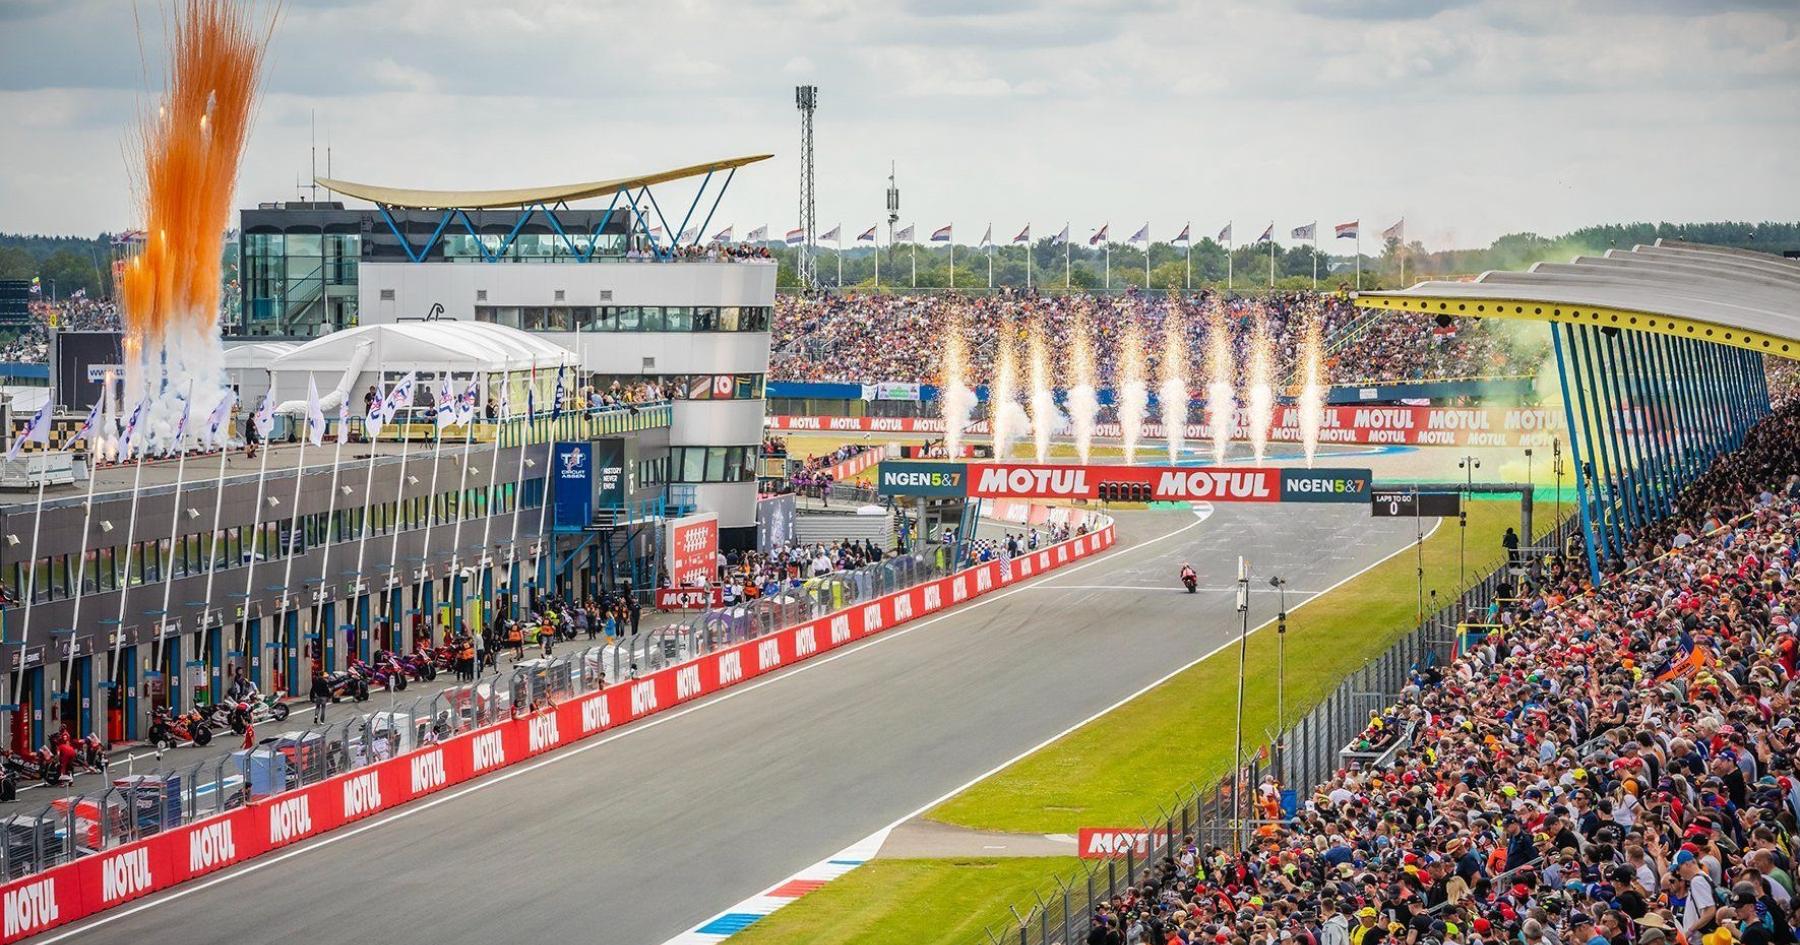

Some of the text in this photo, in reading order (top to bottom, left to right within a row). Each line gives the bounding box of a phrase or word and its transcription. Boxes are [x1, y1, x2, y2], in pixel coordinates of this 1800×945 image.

[789, 417, 820, 429] MOTUL
[830, 417, 861, 429] MOTUL
[870, 418, 903, 430] MOTUL
[1283, 409, 1340, 427] MUL
[1354, 409, 1413, 428] MOTUL
[1429, 410, 1489, 429] MOTUL
[1092, 424, 1121, 436] OTUL
[1272, 428, 1301, 440] MOTU
[1320, 429, 1357, 442] MOTUL
[1368, 430, 1405, 443] MOTUL
[1418, 431, 1455, 444] MOTUL
[1468, 432, 1507, 446] MOTUL
[885, 472, 961, 487] NGEN5&7
[978, 469, 1091, 494] MOTUL
[1156, 471, 1270, 497] MOTUL
[1286, 479, 1365, 493] NGEN5&7
[1390, 501, 1398, 515] 0
[796, 626, 817, 657] MOTUL
[758, 638, 781, 671] MOTUL
[719, 650, 743, 685] MOTUL
[676, 664, 702, 700] MOTUL
[631, 679, 658, 717] MOTUL
[582, 694, 610, 733] MOTUL
[529, 711, 560, 752] MOTUL
[472, 730, 505, 772] MOTUL
[411, 748, 446, 793] MOTUL
[344, 770, 382, 818] MOTUL
[270, 794, 312, 843] MOTUL
[190, 820, 235, 872] MOTUL
[1088, 832, 1176, 853] MOTU
[102, 847, 152, 902] MOTUL
[3, 878, 58, 938] MOTUL
